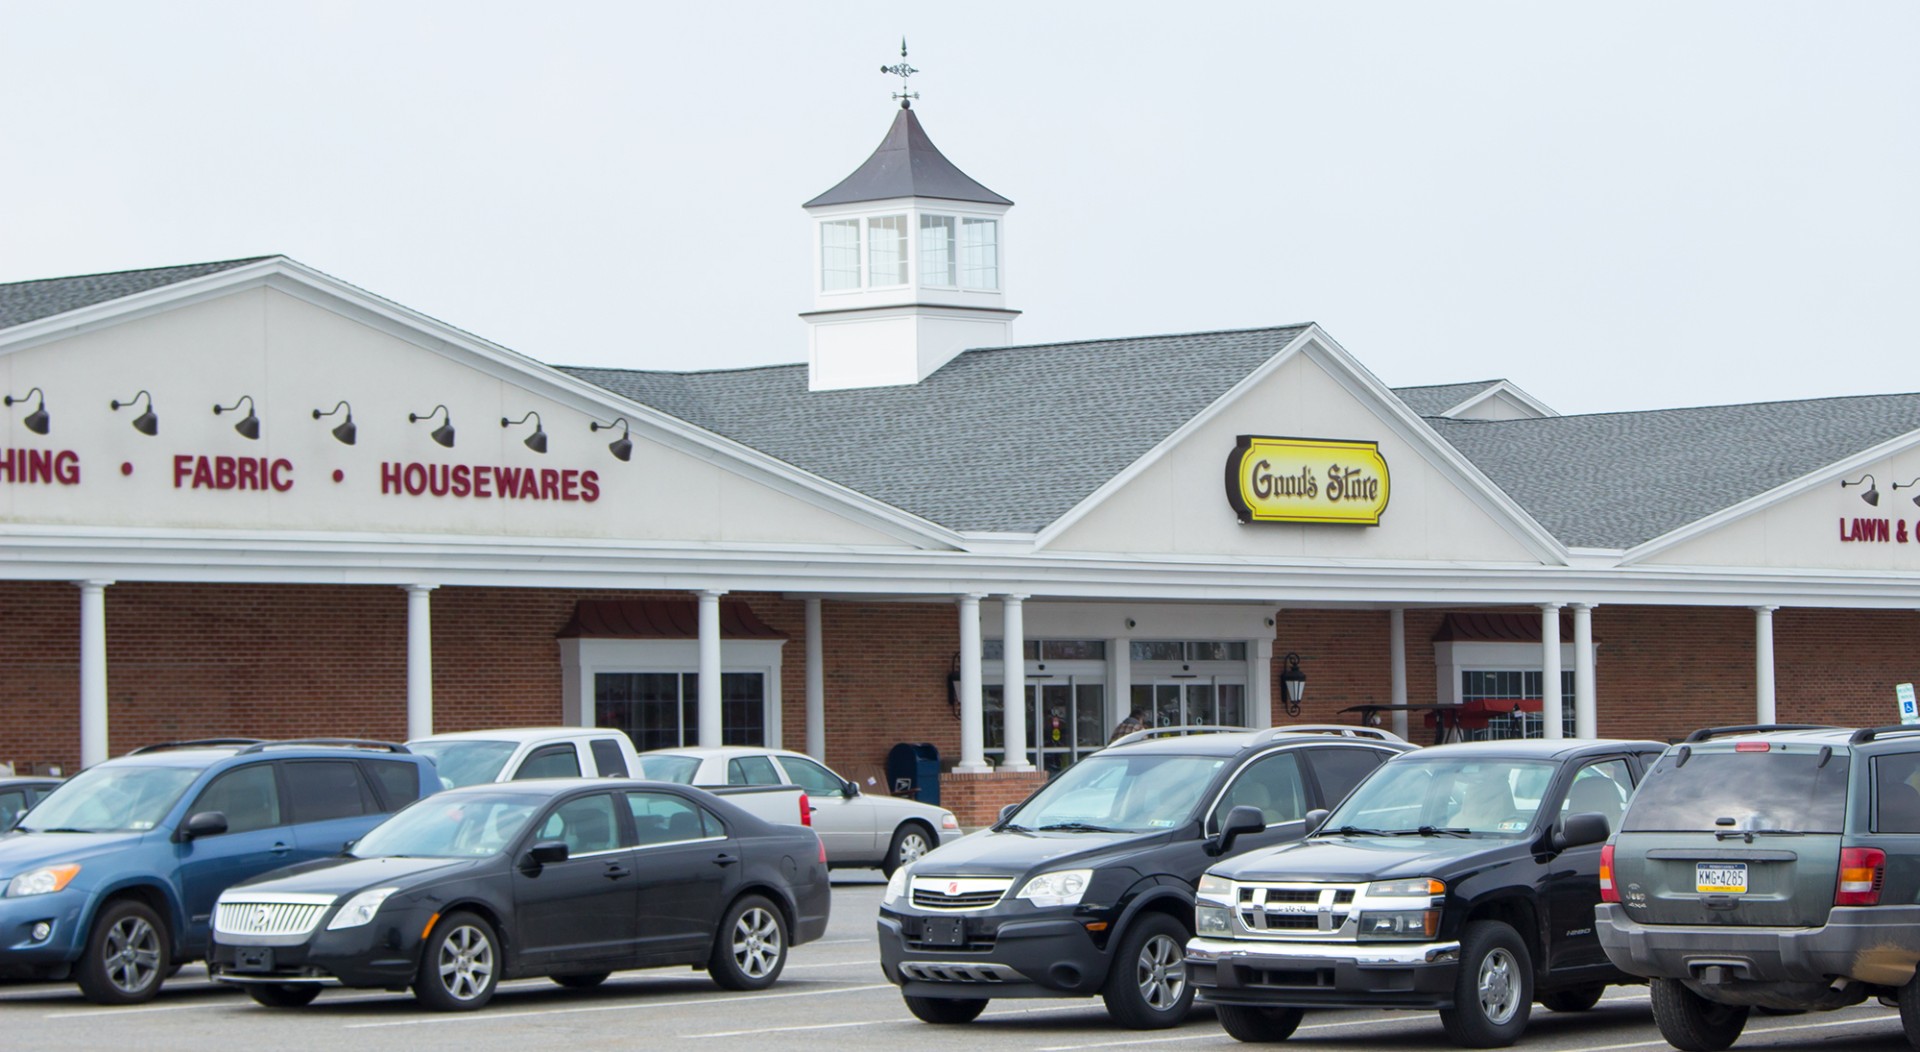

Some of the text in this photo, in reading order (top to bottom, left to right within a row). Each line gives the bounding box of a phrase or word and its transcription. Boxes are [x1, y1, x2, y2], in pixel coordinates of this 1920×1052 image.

[173, 455, 294, 492] FABRIC
[381, 462, 600, 503] HOUSEWARES
[1252, 459, 1378, 501] Good's Store
[1840, 517, 1890, 542] LAWN
[1896, 518, 1909, 544] &
